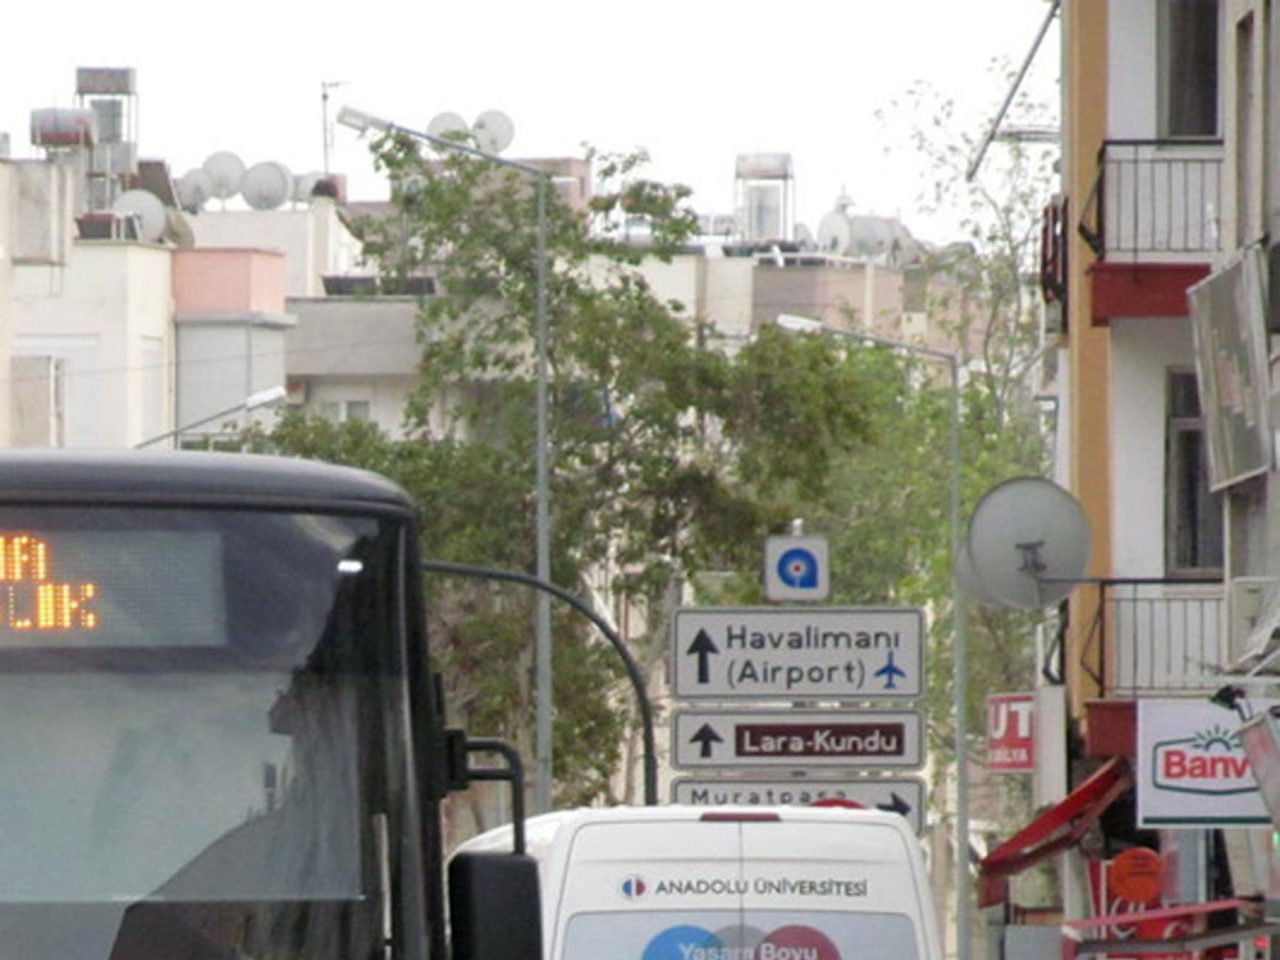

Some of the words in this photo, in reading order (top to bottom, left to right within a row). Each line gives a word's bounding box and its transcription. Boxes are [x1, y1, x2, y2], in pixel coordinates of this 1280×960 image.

[726, 625, 900, 650] Havalimanı
[726, 660, 866, 690] (Airport)
[742, 730, 898, 753] Lara-Kundu
[655, 879, 749, 896] ANADOLU
[754, 877, 868, 897] ÜNİVERSİTESİ
